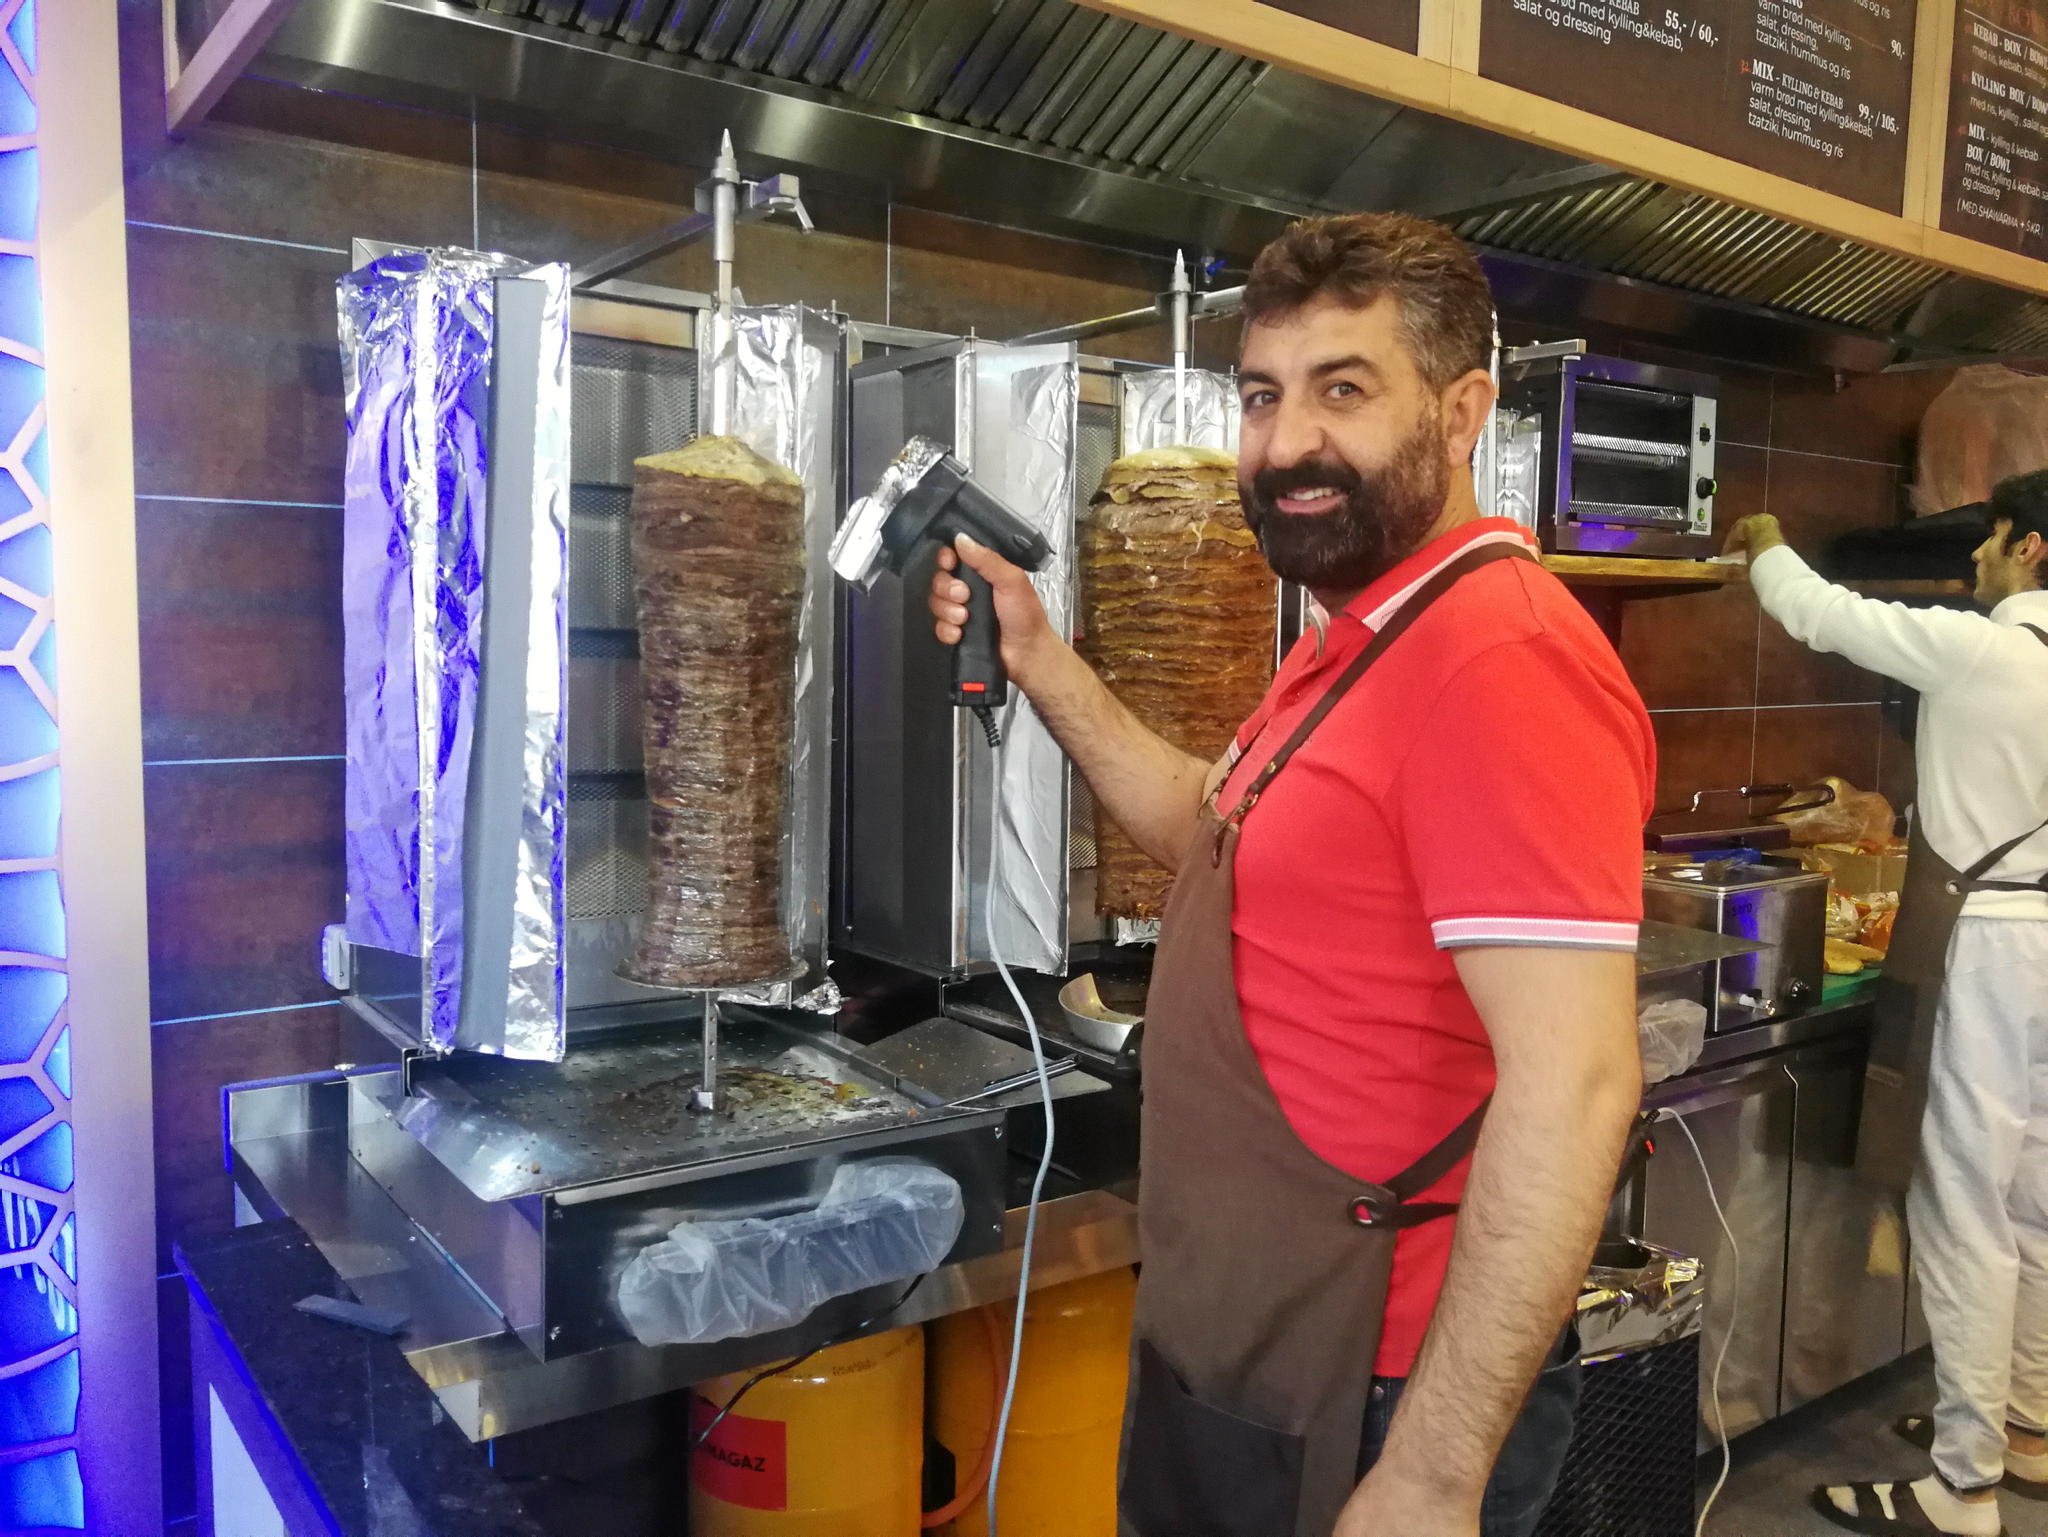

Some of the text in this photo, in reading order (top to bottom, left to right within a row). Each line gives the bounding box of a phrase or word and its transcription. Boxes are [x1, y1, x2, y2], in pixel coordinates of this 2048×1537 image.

[1514, 0, 1611, 45] salat og dressing
[1551, 0, 1684, 52] rød med kylling&kebab,
[1665, 9, 1719, 47] 55,- / 60,-
[1758, 0, 1781, 16] varm
[1783, 6, 1803, 26] brød
[1804, 17, 1823, 35] med
[1881, 5, 1890, 19] ris
[1757, 12, 1818, 51] salat, dressing,
[1973, 22, 1998, 47] KEBAB
[2004, 38, 2022, 57] BOX
[1756, 28, 1851, 80] tzatziki, hummus og ris
[1751, 80, 1774, 98] varm
[1776, 88, 1796, 107] brød
[1797, 99, 1818, 116] med
[1752, 59, 1774, 82] MIX
[1782, 73, 1813, 97] KYLLING
[1814, 87, 1820, 100] &
[1821, 90, 1844, 110] KEBAB
[1971, 71, 2006, 97] KYLLING
[2009, 86, 2025, 105] BOX
[1749, 96, 1812, 132] salat, dressing,
[1748, 112, 1844, 159] tzatziki, hummus og ris
[1968, 123, 1986, 142] MIX
[2016, 145, 2039, 162] kebab
[1965, 163, 1981, 176] med
[1966, 143, 1984, 163] BOX
[1990, 152, 2012, 174] BOWL
[1962, 177, 2001, 201] og dressing
